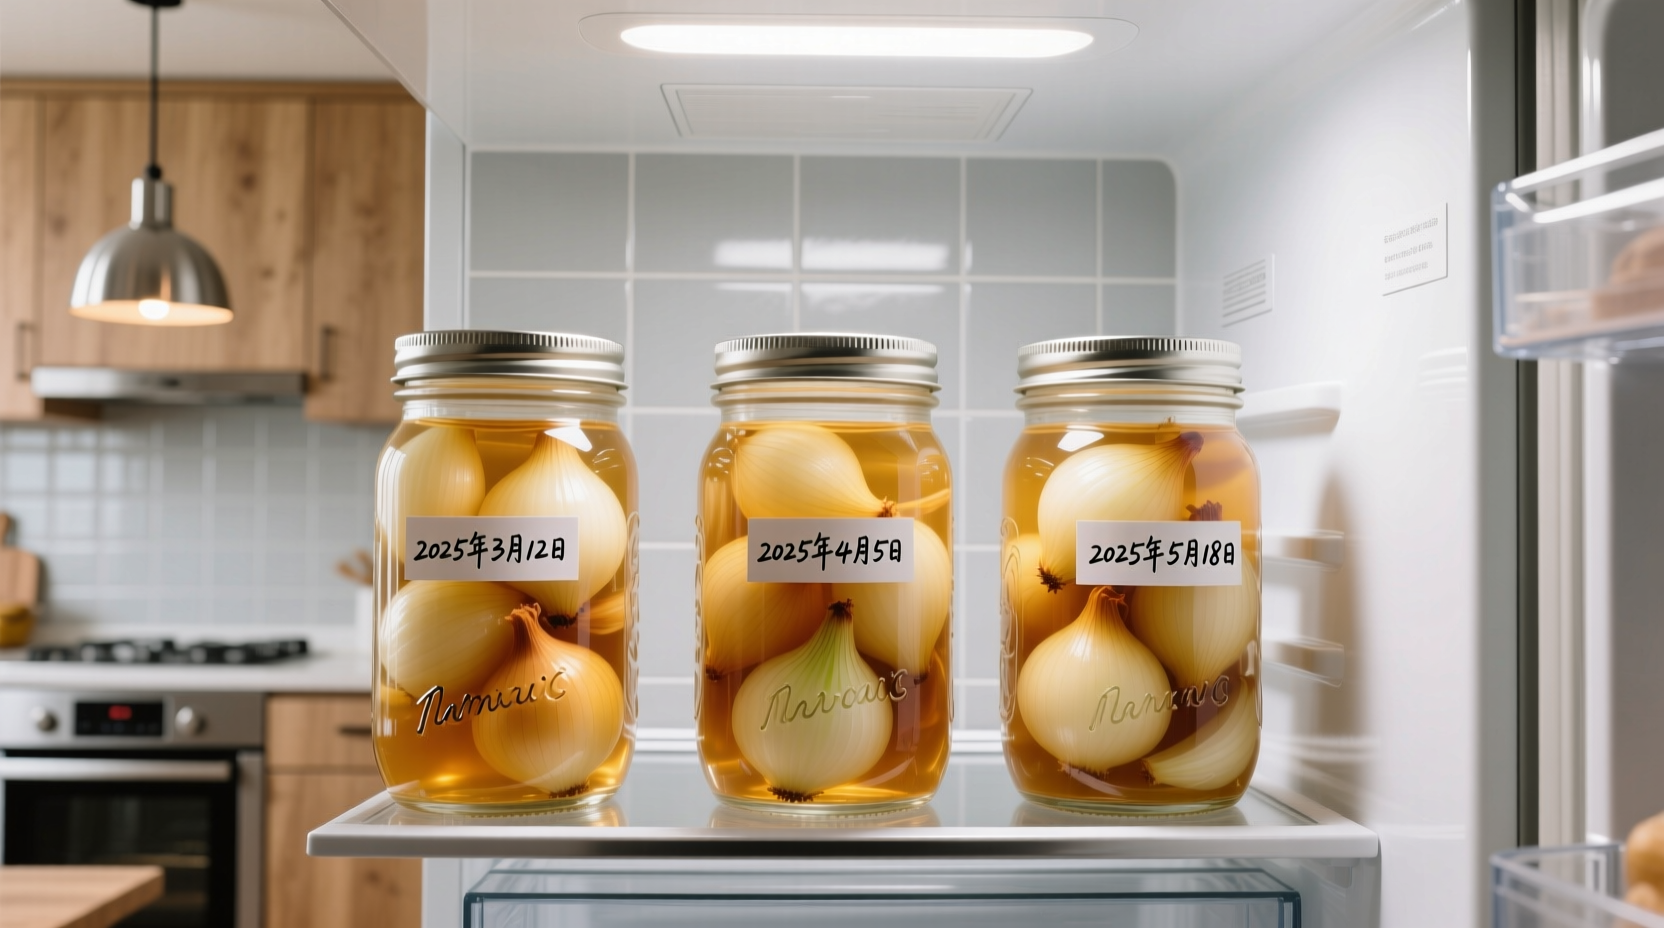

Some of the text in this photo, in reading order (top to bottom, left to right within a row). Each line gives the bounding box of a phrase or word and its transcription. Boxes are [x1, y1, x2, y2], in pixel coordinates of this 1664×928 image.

[413, 531, 565, 569] 2025年3月12日
[757, 532, 902, 571] 2025年4月5日
[1089, 535, 1235, 573] 2025年5月18日
